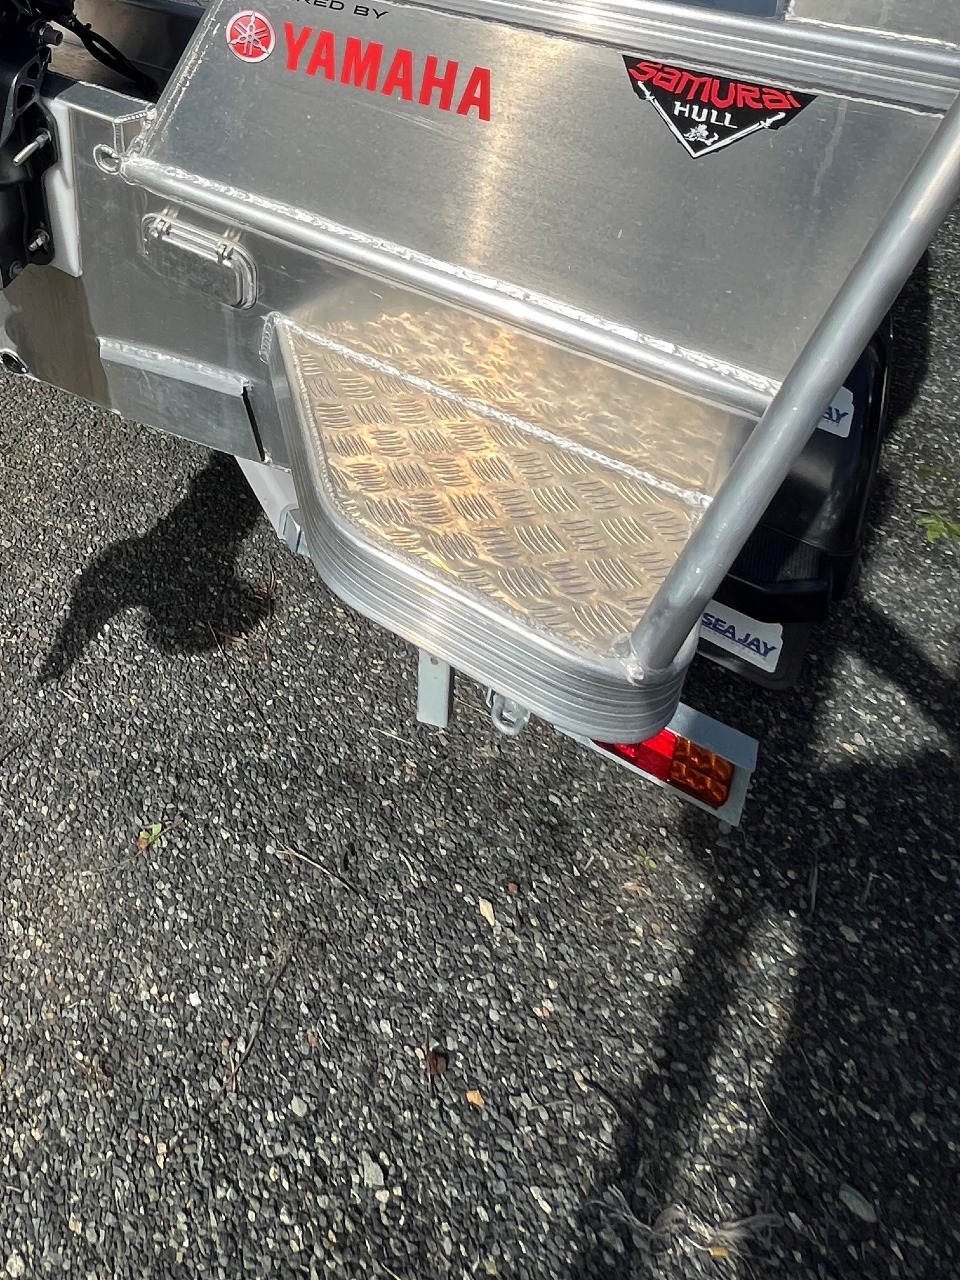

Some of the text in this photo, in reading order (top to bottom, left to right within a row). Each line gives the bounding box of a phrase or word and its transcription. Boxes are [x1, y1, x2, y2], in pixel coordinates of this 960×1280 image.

[353, 4, 389, 20] BY
[283, 21, 491, 122] YAMAHA
[673, 100, 739, 129] HULL
